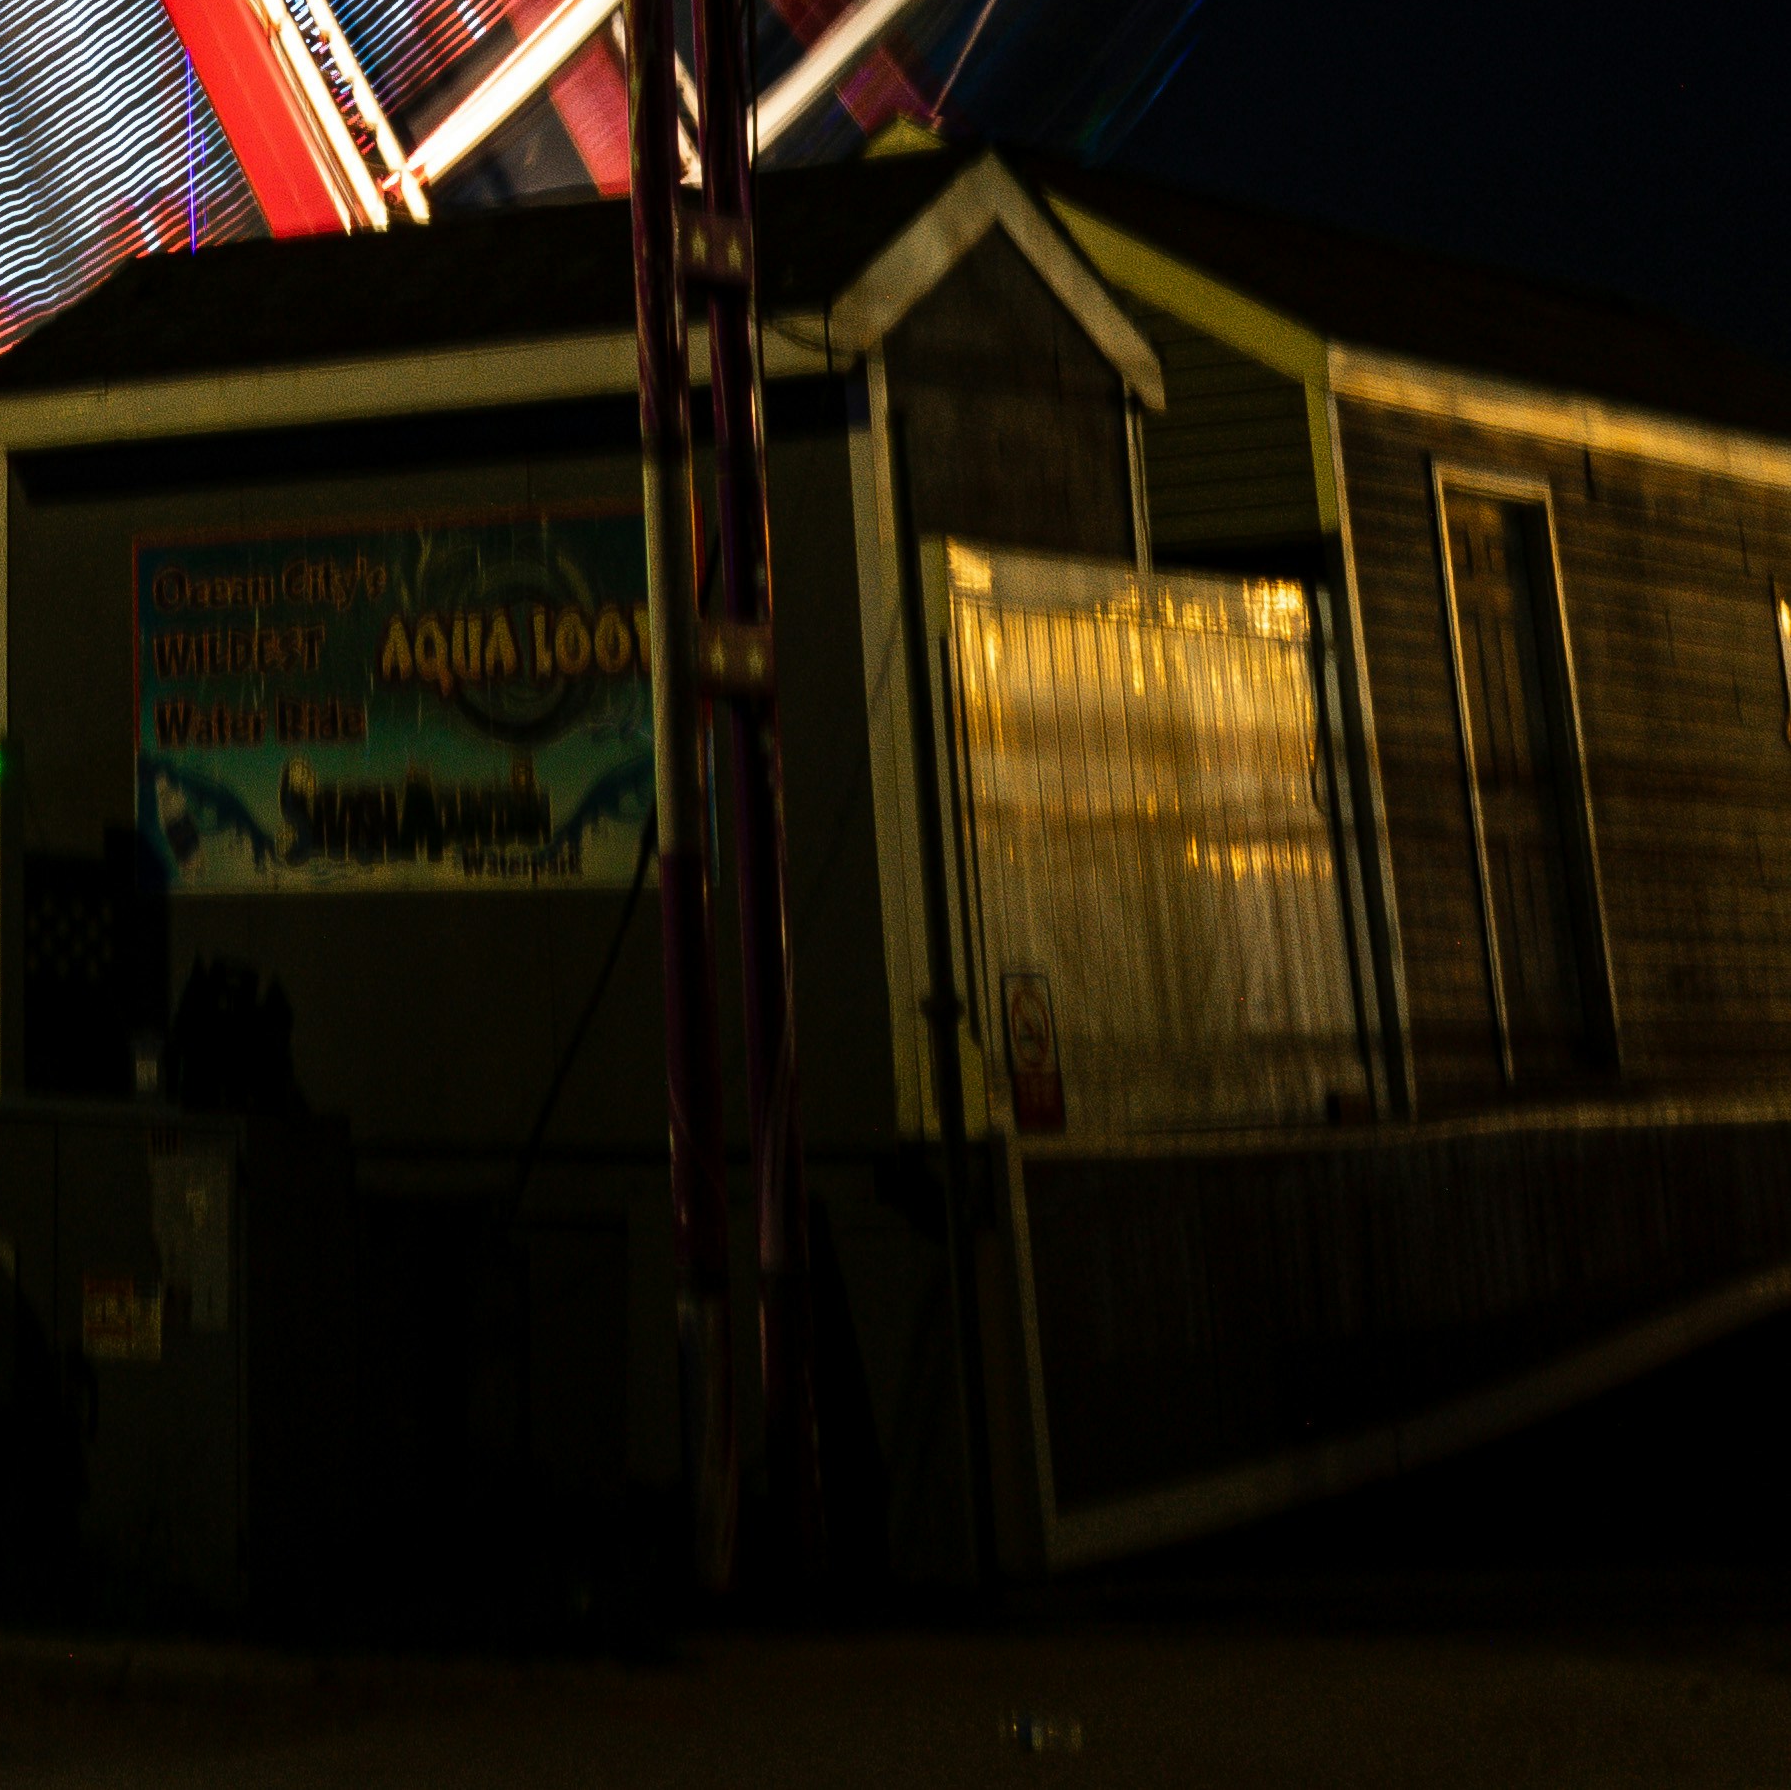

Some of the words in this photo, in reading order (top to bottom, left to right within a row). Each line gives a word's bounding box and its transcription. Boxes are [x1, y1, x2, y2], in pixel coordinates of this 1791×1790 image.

[152, 566, 276, 614] Ocean
[152, 623, 326, 680] WILDEST
[378, 607, 520, 699] AQUA
[153, 697, 268, 748] Water
[275, 695, 367, 745] Ride
